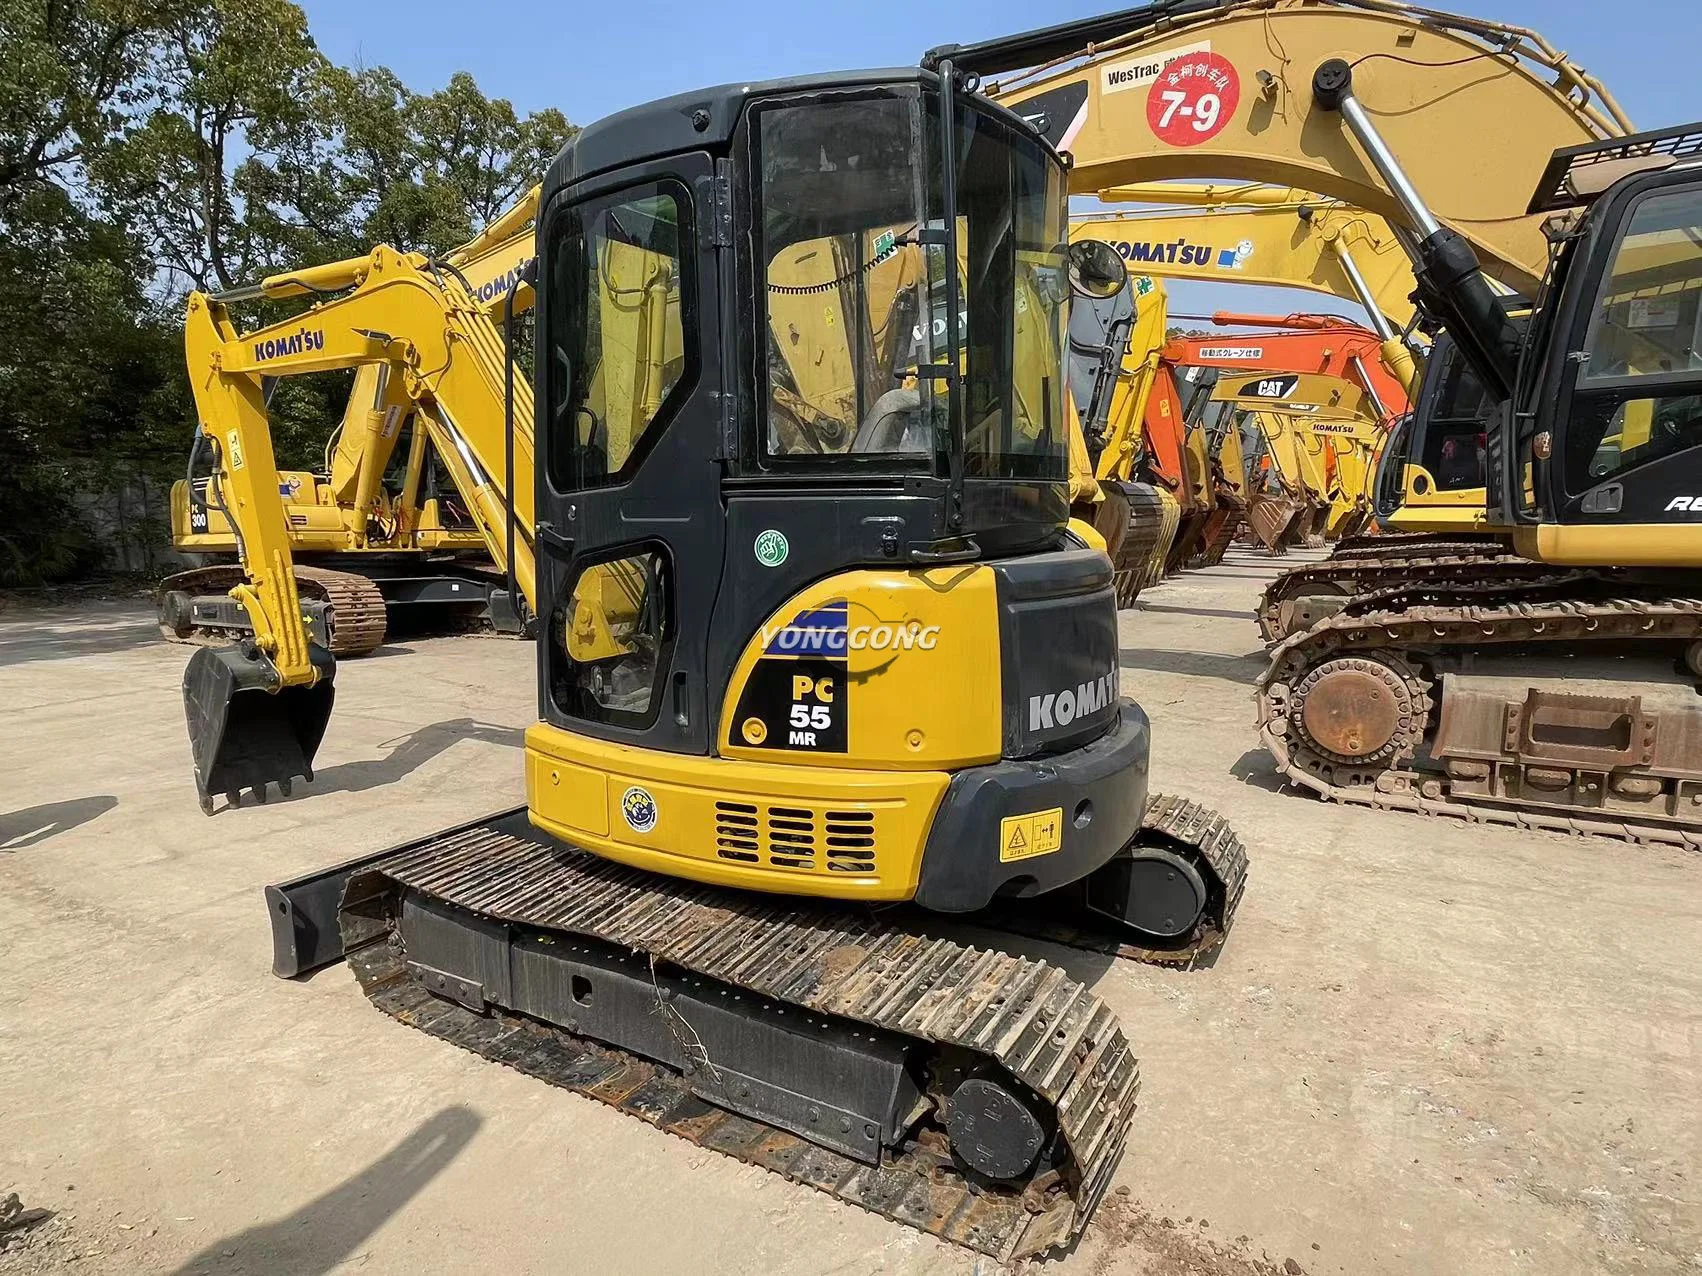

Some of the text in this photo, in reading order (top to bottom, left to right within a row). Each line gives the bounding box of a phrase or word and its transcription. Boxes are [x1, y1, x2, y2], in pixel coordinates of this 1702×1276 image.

[1108, 63, 1159, 85] WesTrac
[1158, 90, 1221, 132] 7-9
[255, 328, 323, 361] KOMATSU
[1258, 381, 1284, 396] CAT
[1313, 424, 1353, 432] KOMATSU
[191, 513, 206, 527] 300
[793, 675, 834, 703] PC
[789, 704, 831, 730] 55
[789, 731, 817, 747] MR
